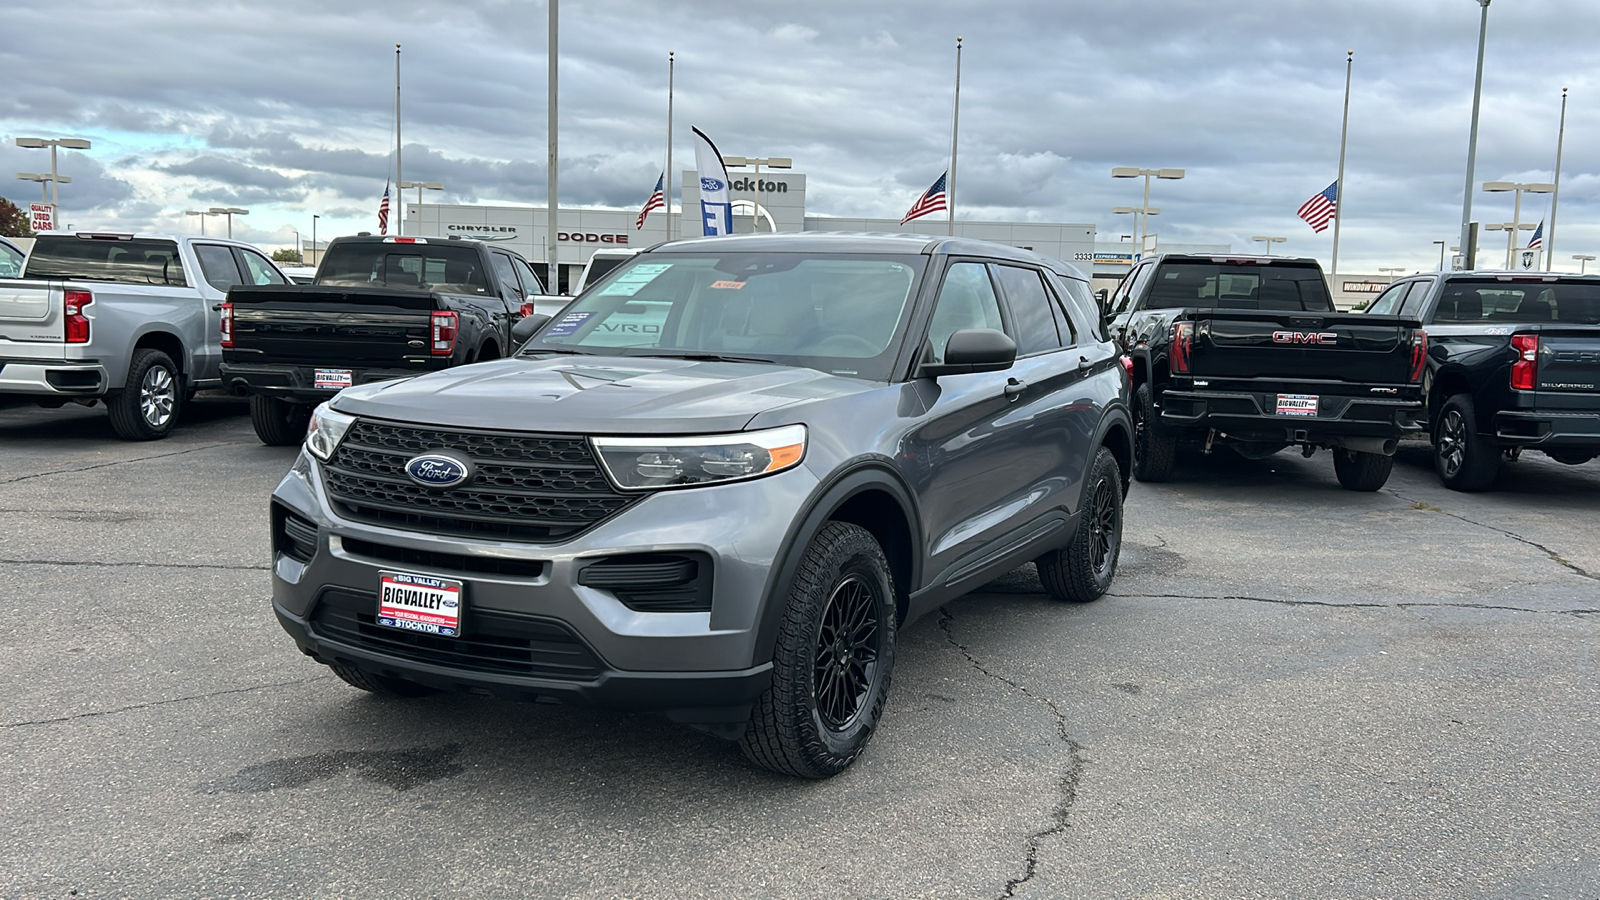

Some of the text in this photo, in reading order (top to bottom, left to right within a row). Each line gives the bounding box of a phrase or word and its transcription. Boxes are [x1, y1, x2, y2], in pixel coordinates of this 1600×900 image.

[31, 204, 52, 212] QUALITY
[34, 213, 50, 221] USED
[32, 220, 53, 230] CARS
[448, 224, 517, 233] CHRYSLER
[557, 232, 628, 244] DODGE
[1074, 252, 1093, 261] 3333
[1343, 283, 1370, 291] WINDOW
[1272, 330, 1338, 345] GMC
[1278, 400, 1309, 408] BIGVALLEY
[417, 460, 452, 480] Ford
[398, 575, 441, 587] BIG VALLEY
[383, 587, 443, 610] BIGVALLEY
[394, 619, 440, 633] STOCKTON
